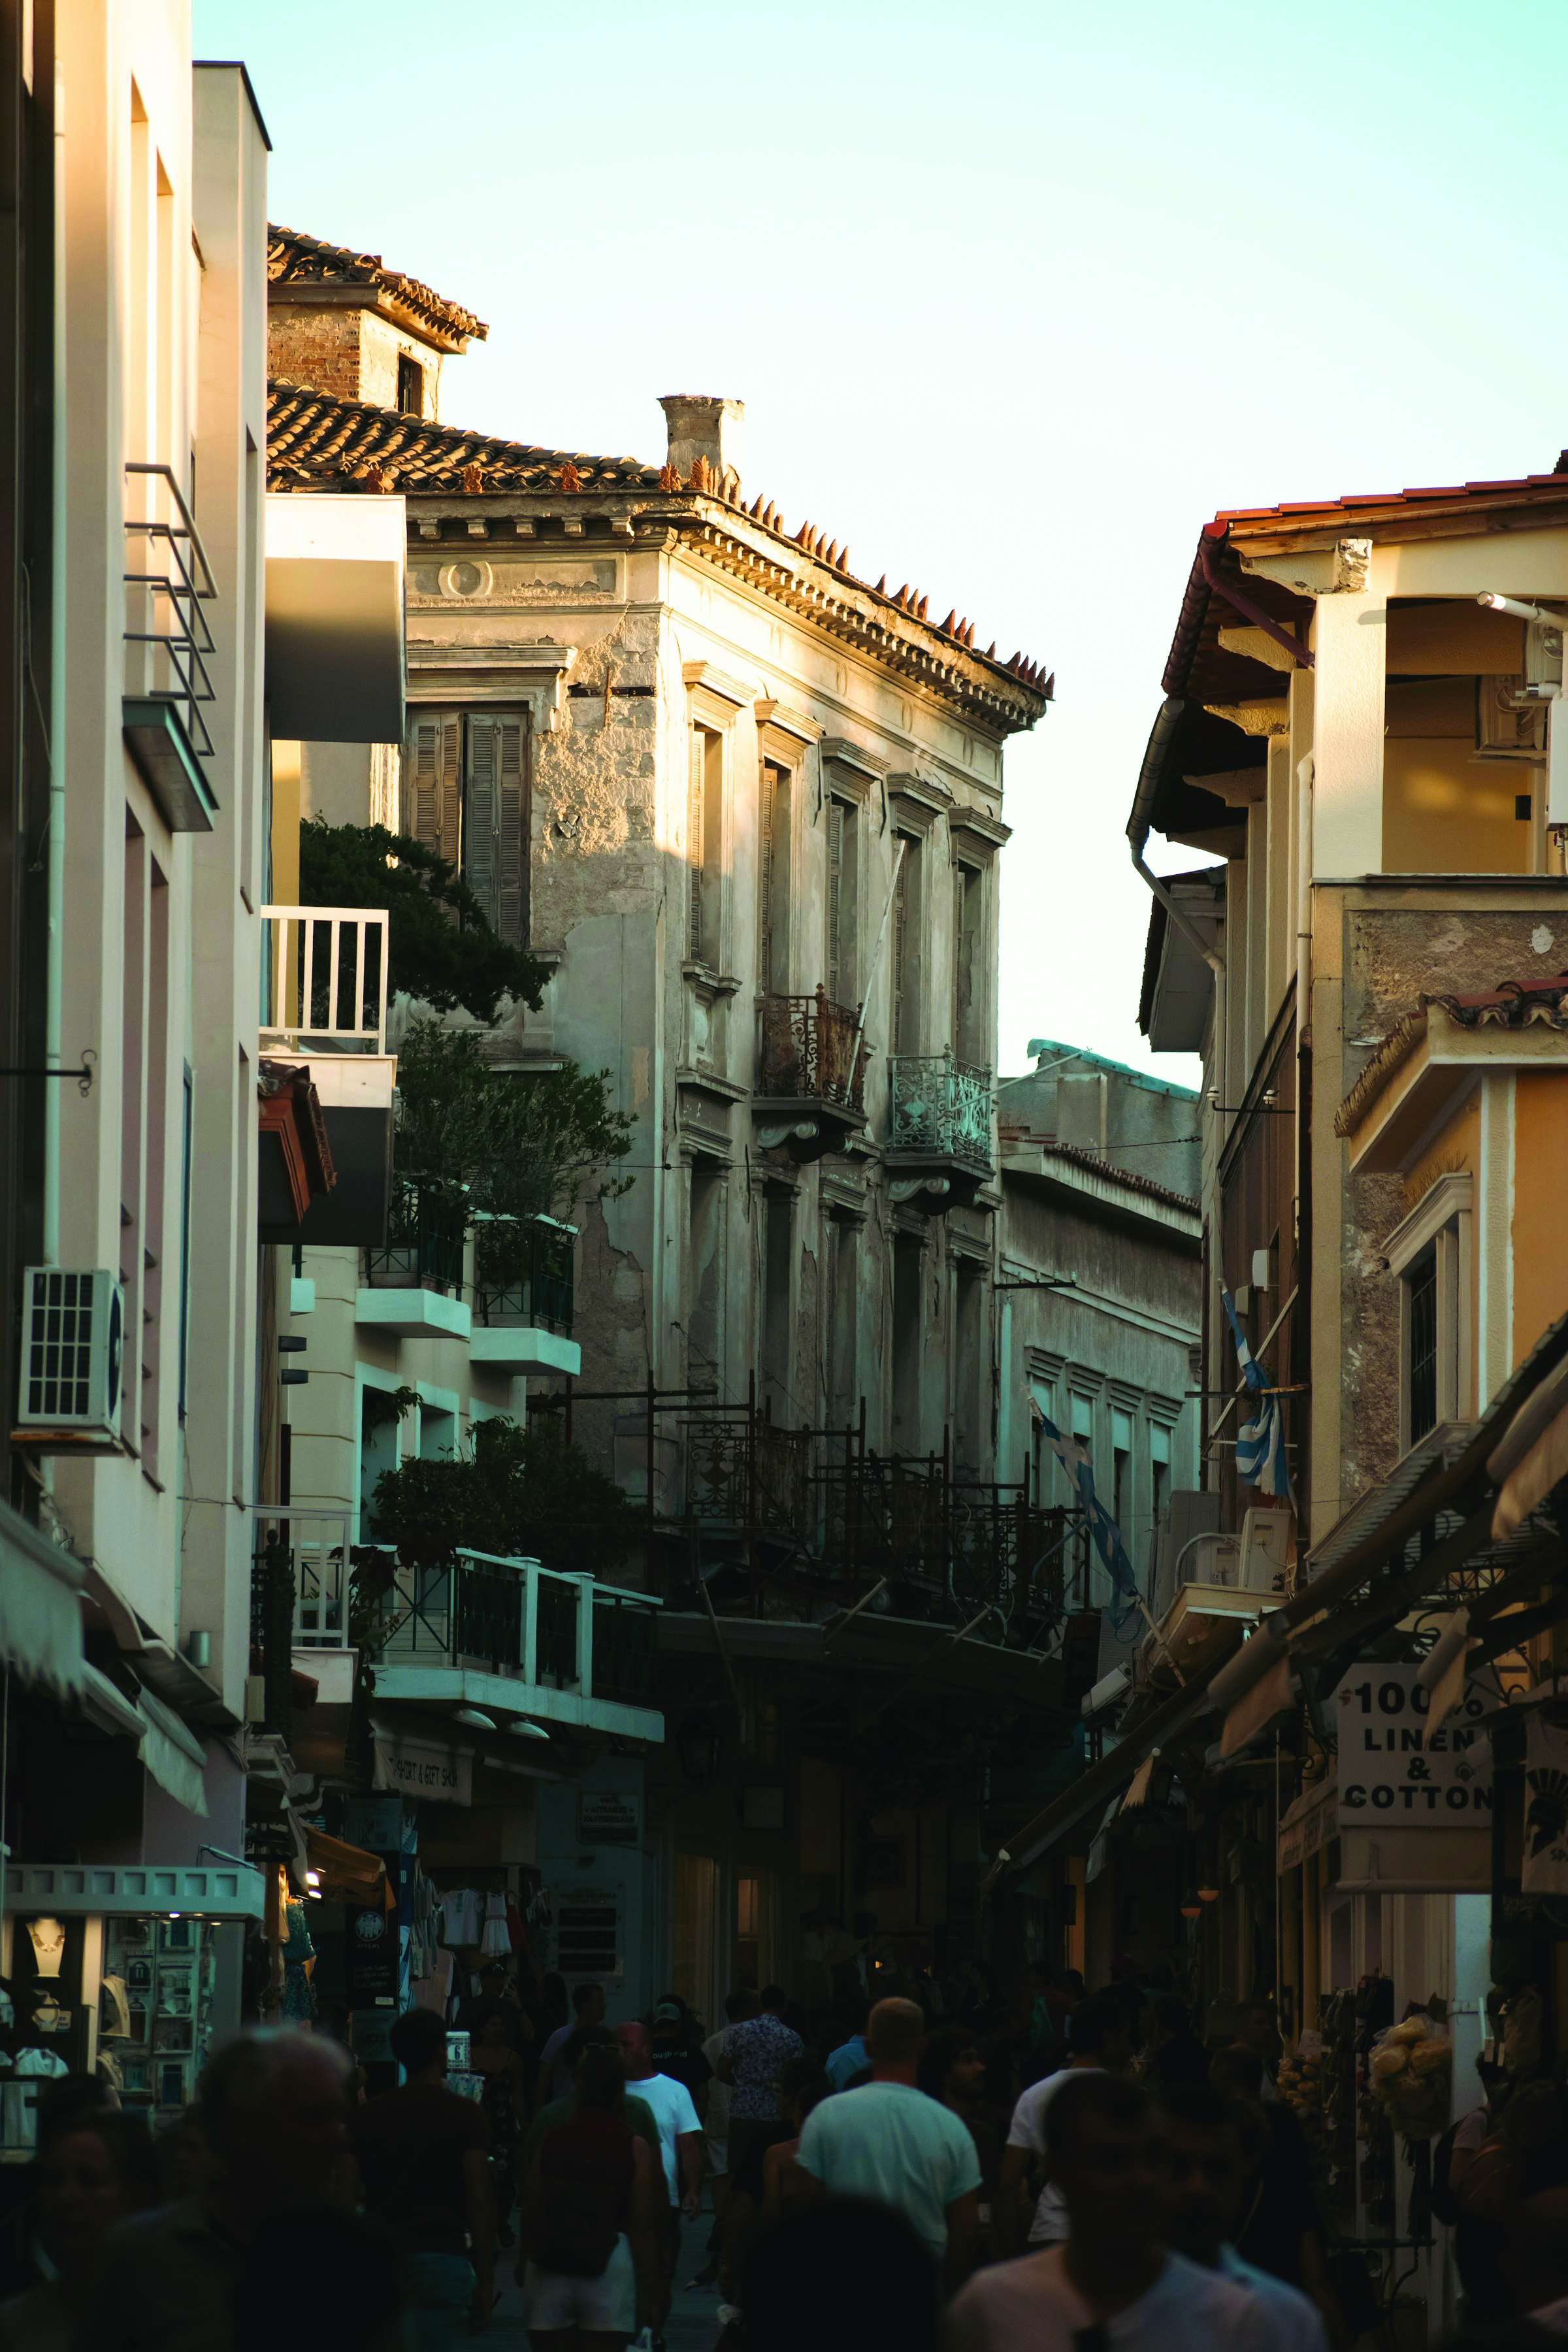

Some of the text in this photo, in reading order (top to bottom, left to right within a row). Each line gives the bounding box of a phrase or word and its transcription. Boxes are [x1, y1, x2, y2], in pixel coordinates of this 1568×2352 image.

[1355, 1682, 1483, 1717] 100%
[1365, 1729, 1475, 1752] LINEN
[424, 1765, 440, 1786] GIFT
[1407, 1757, 1431, 1780] &
[1345, 1785, 1493, 1810] COTTON
